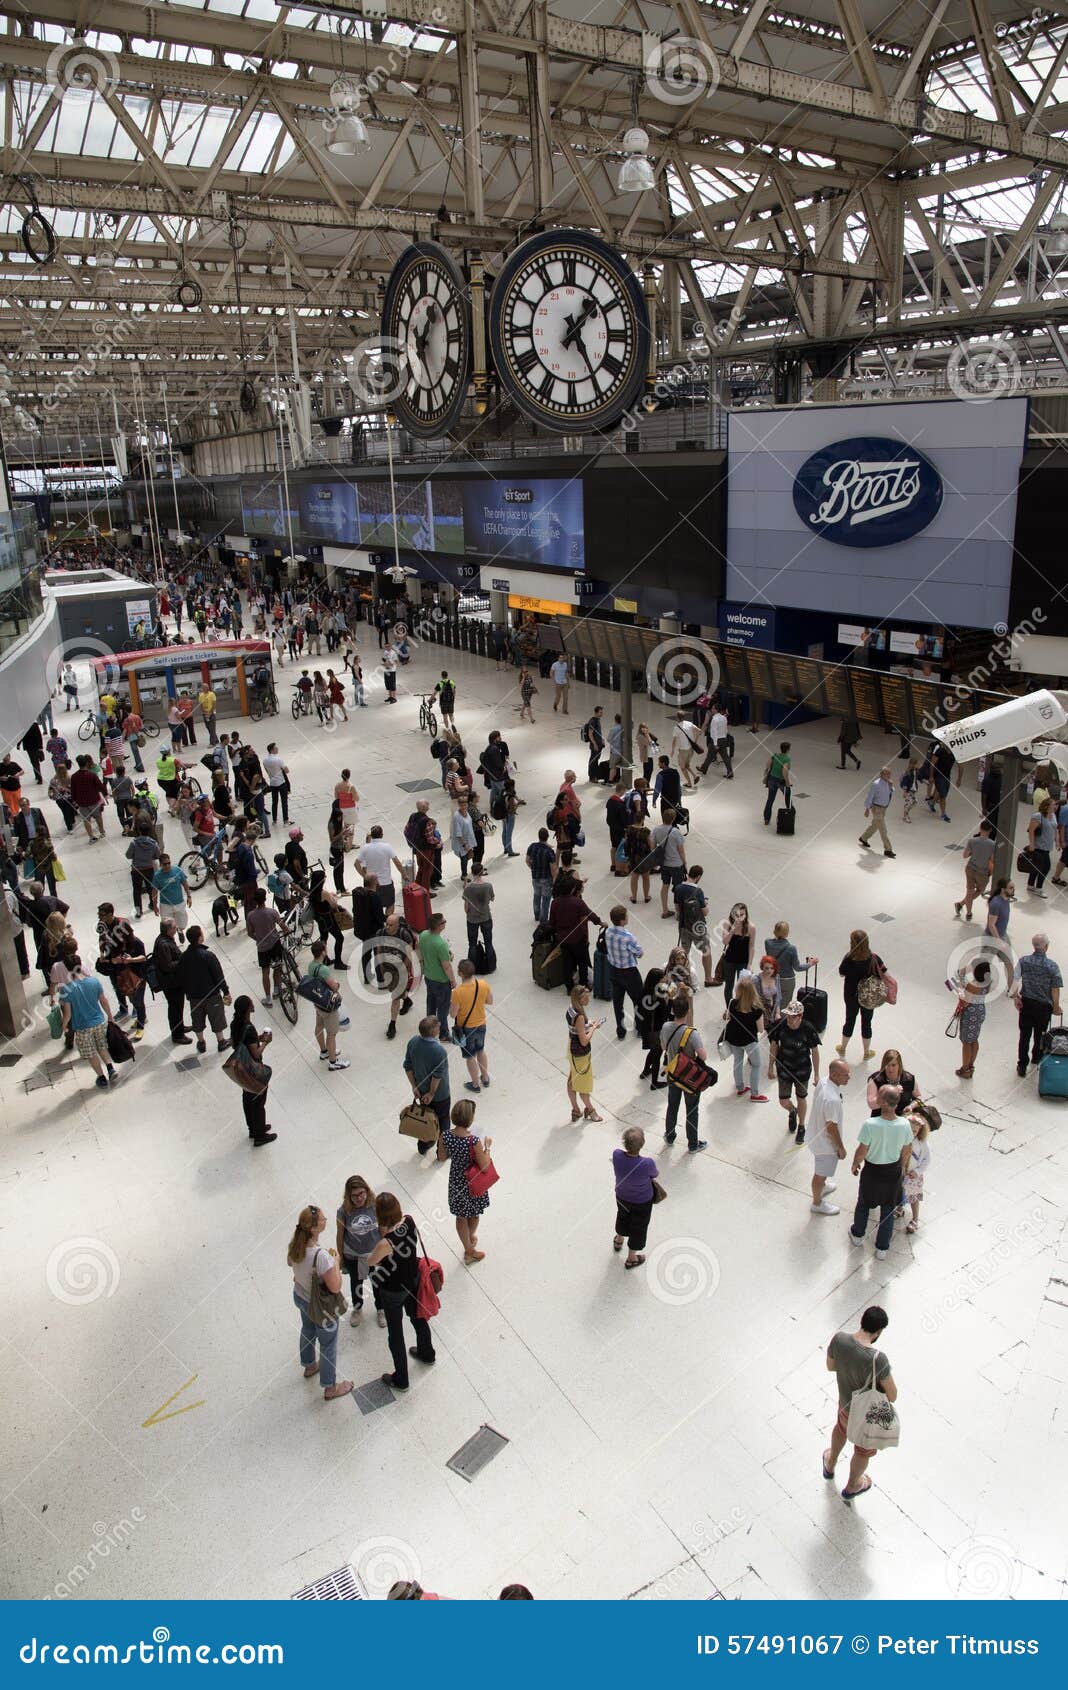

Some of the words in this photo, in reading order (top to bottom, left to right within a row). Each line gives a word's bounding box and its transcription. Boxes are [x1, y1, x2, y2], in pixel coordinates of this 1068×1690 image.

[514, 491, 531, 503] Sport
[809, 459, 920, 525] Boots
[484, 507, 493, 519] The
[506, 511, 521, 522] place
[522, 511, 528, 520] to
[484, 523, 499, 535] UEFA
[464, 566, 474, 576] 10
[585, 582, 593, 593] 11
[727, 613, 767, 627] welcome
[727, 628, 755, 638] pharmacy
[727, 636, 746, 647] beauty
[154, 655, 193, 665] Self-service
[195, 651, 218, 660] tickets
[949, 729, 987, 749] PHILIPS
